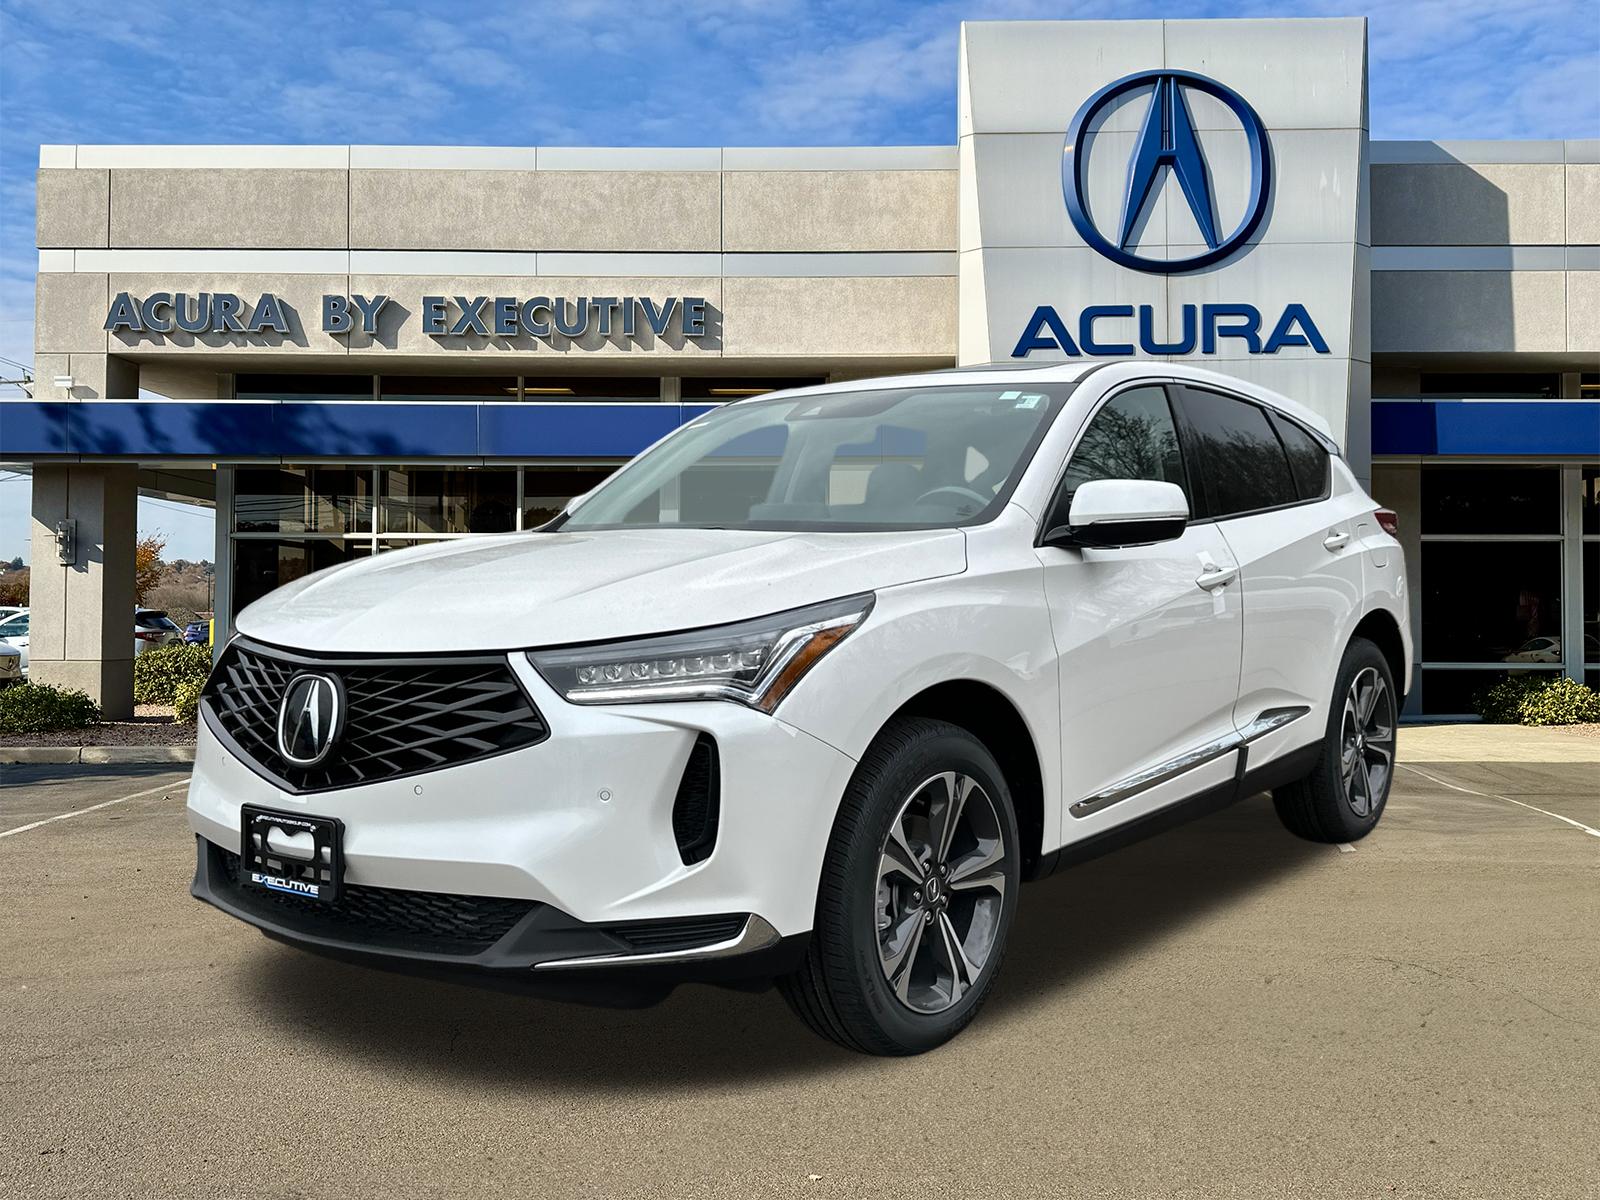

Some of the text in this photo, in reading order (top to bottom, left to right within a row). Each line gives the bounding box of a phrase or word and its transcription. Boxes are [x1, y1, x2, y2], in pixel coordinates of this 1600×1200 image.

[104, 291, 709, 337] ACURA BY EXECUTIVE
[1011, 303, 1332, 357] ACURA
[251, 873, 320, 895] EXECUTIVE
